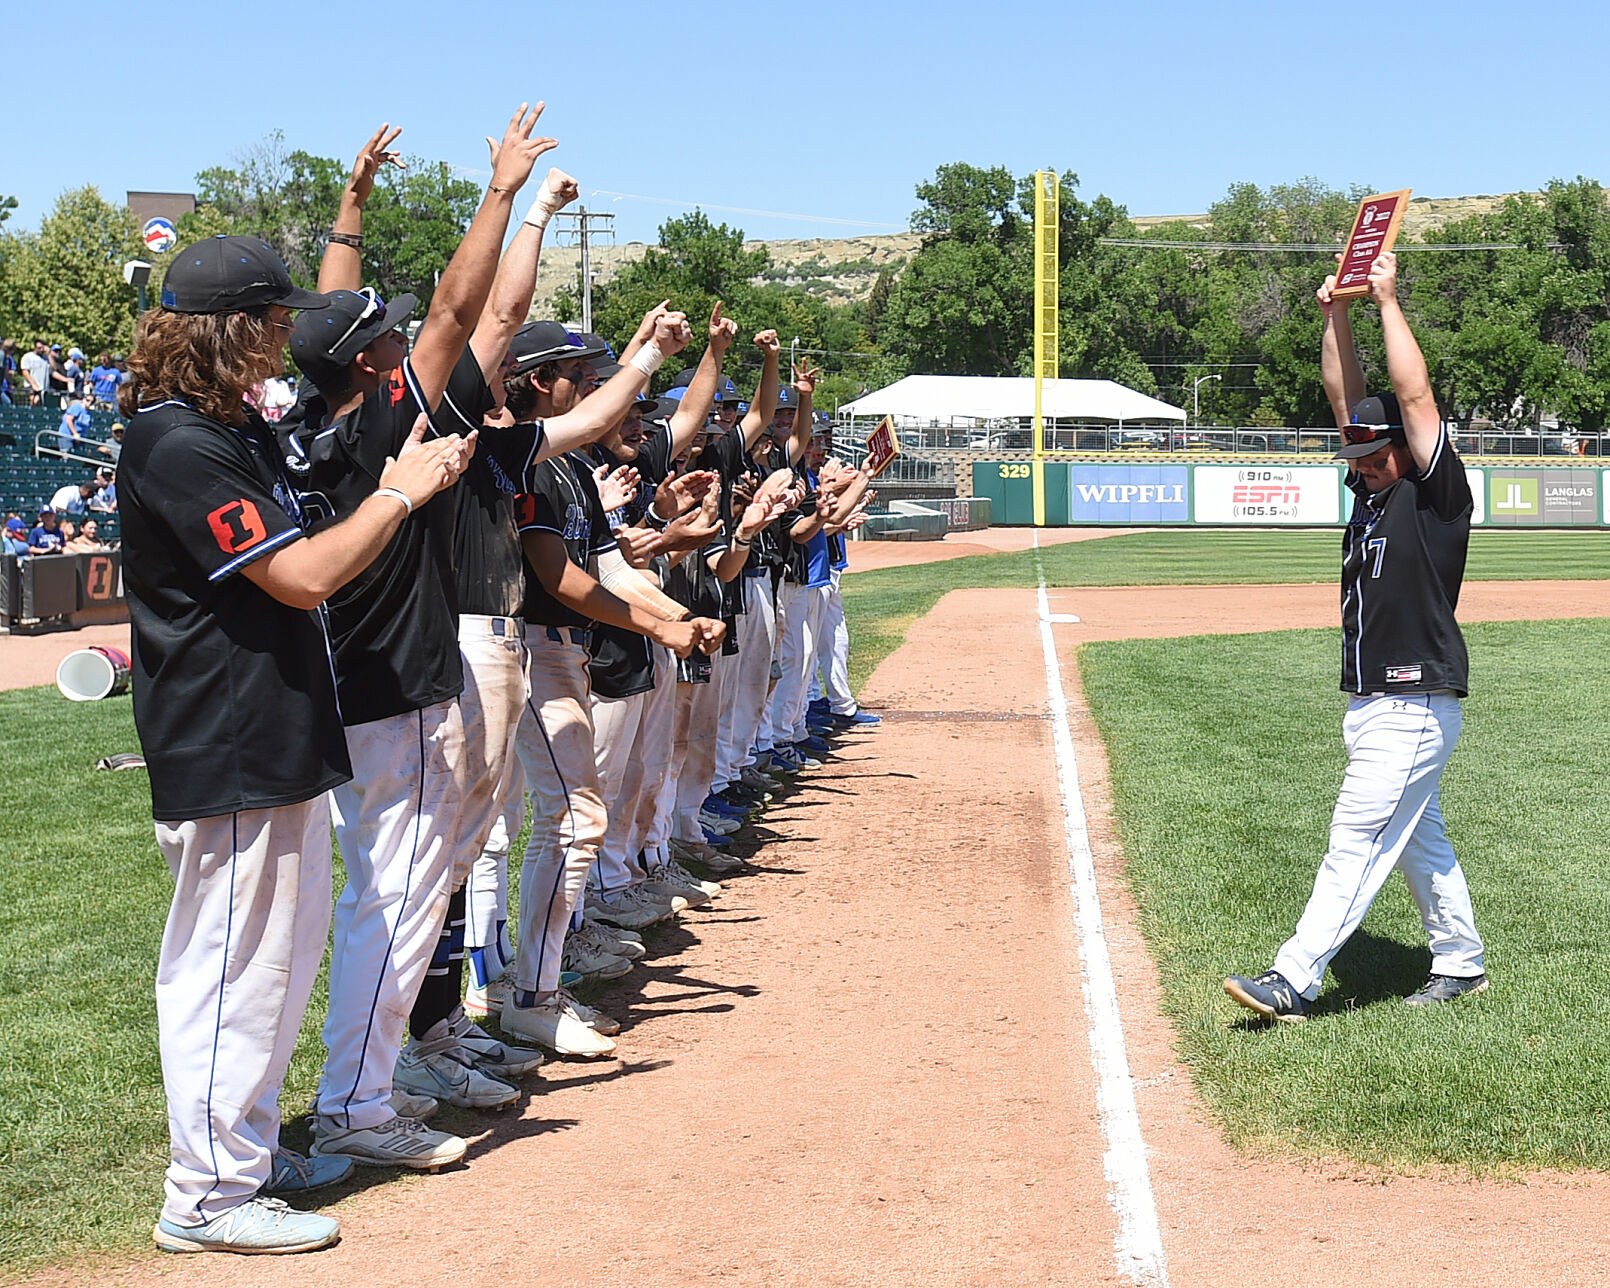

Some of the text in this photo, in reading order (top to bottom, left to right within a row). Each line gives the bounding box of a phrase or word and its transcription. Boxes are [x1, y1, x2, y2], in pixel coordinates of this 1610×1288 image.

[998, 464, 1031, 479] 329
[1247, 471, 1271, 481] 910
[1075, 484, 1185, 503] WIPFLI
[1232, 485, 1300, 504] ESPN
[1545, 487, 1594, 497] LANGLAS
[1242, 506, 1278, 516] 105.5
[1368, 537, 1387, 579] 7
